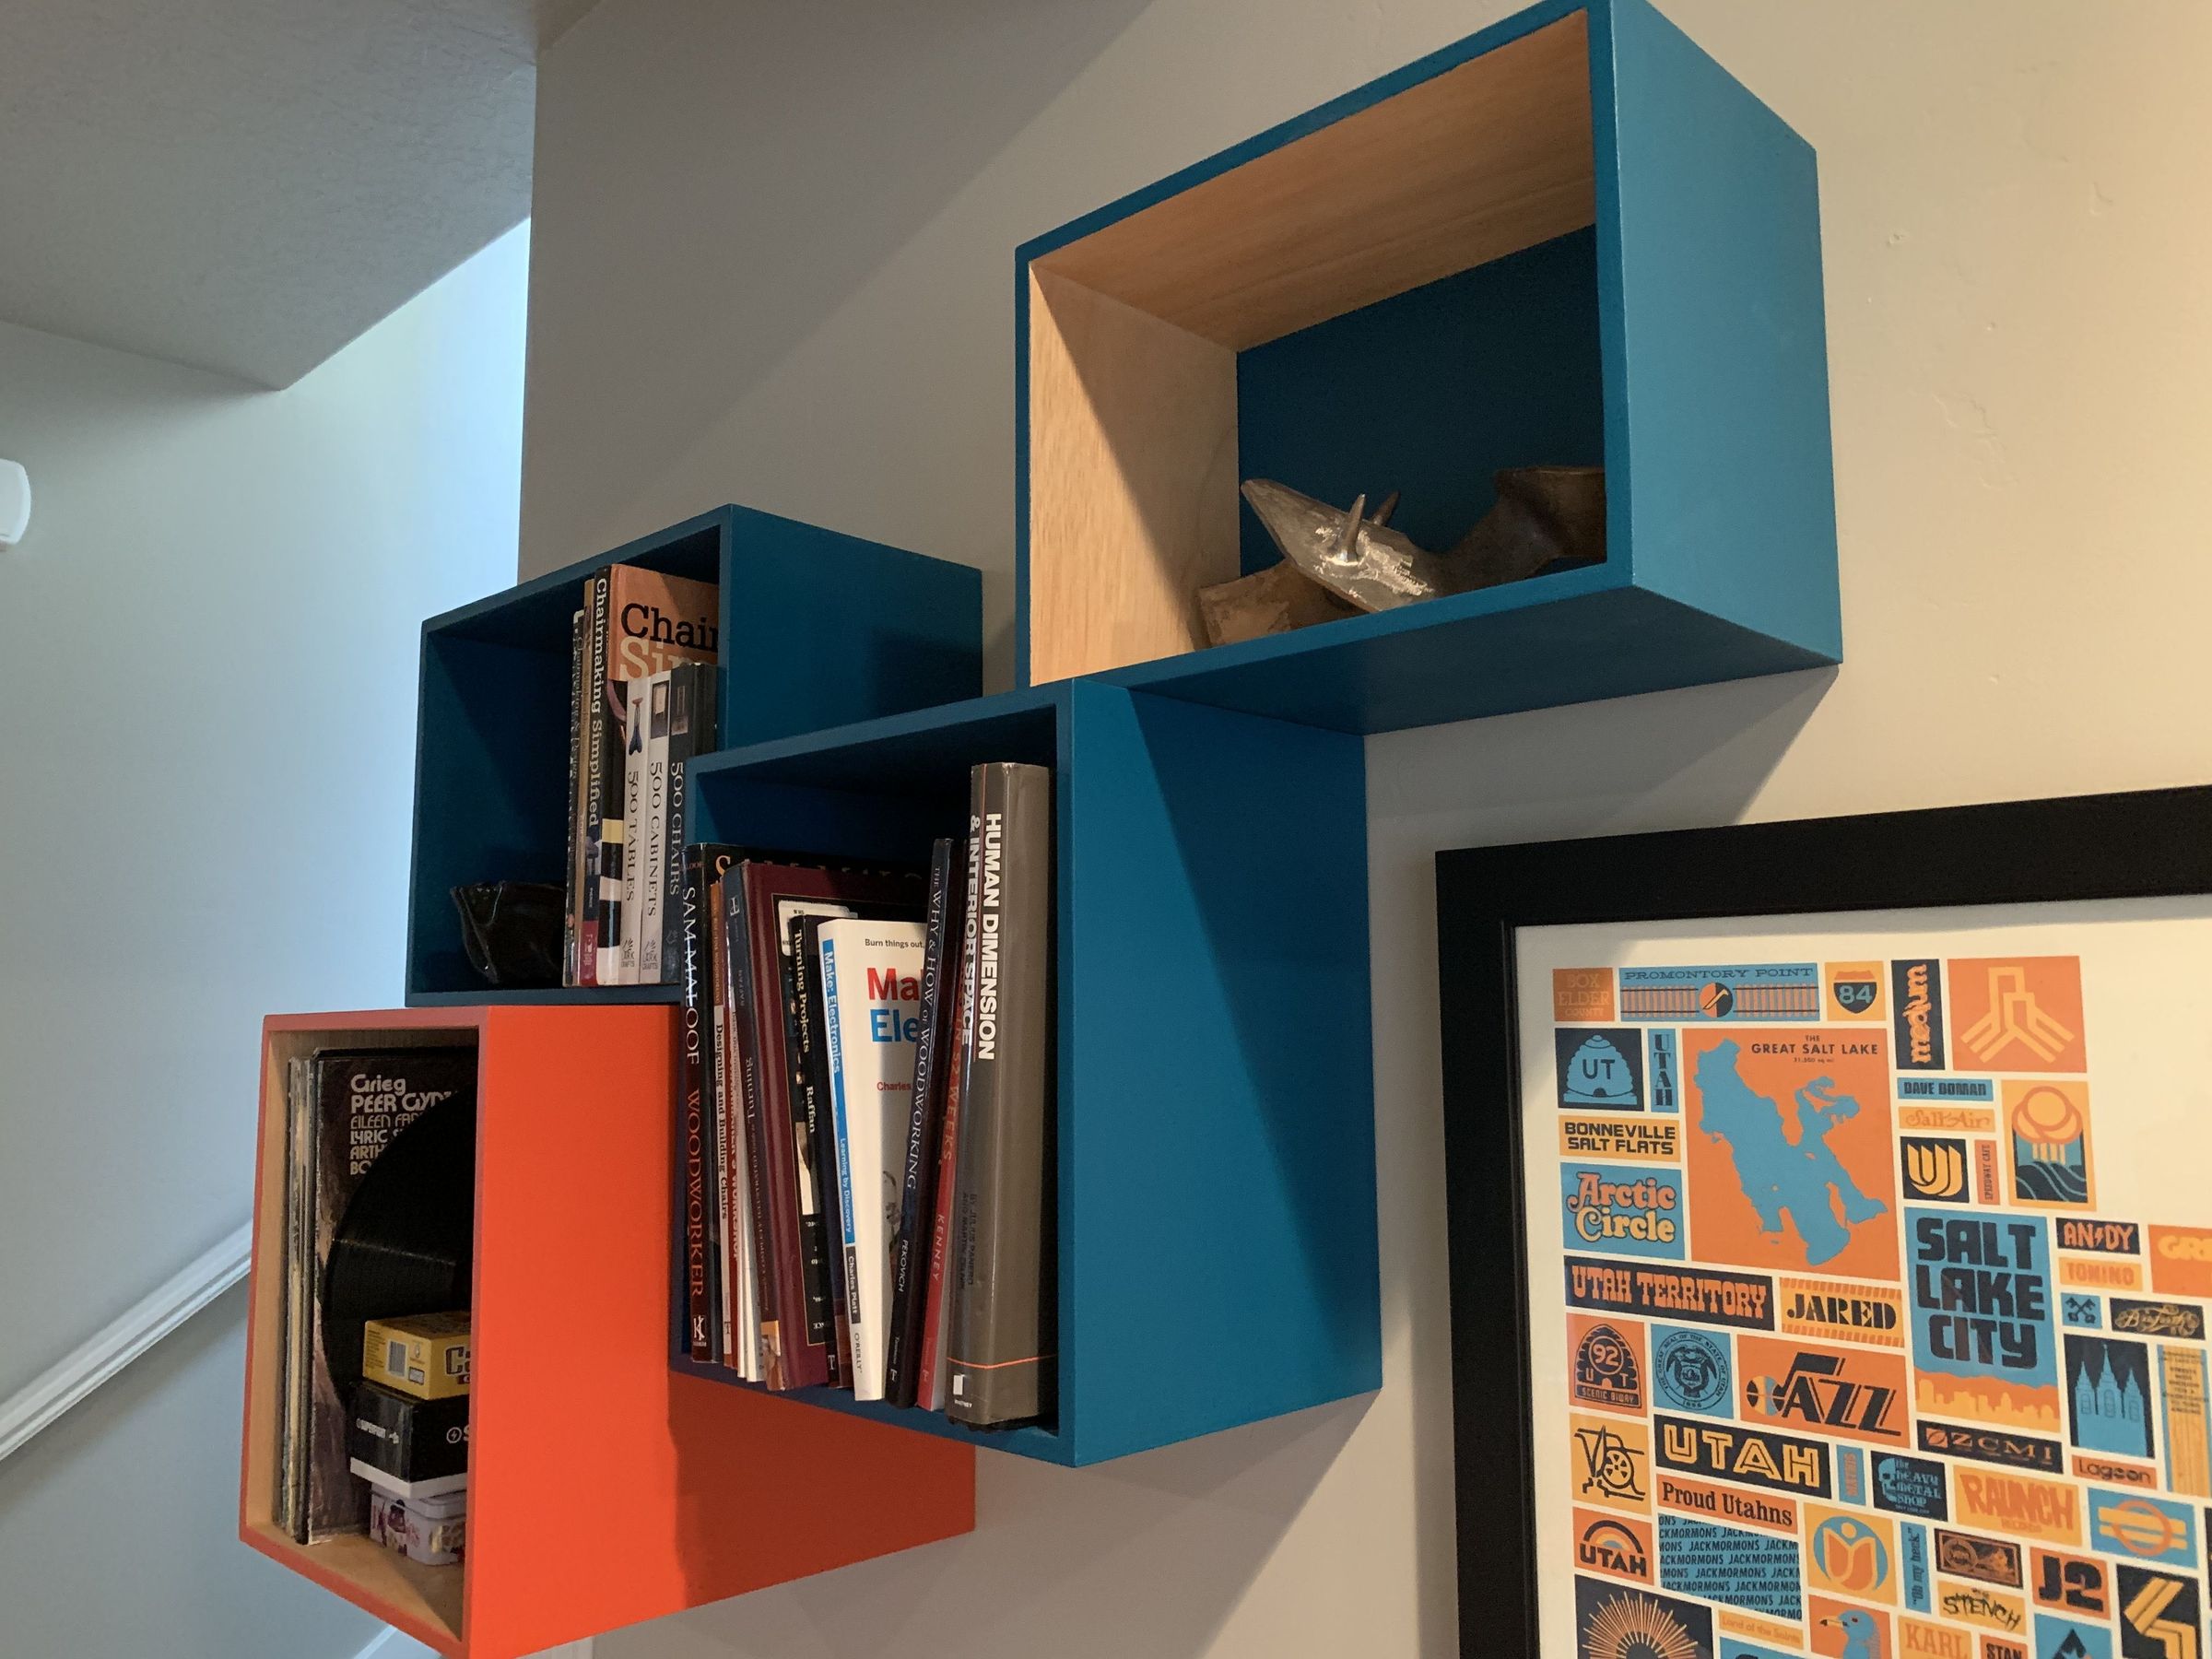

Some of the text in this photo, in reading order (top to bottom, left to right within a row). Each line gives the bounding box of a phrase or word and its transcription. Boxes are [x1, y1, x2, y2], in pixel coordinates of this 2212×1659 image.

[588, 578, 606, 826] Chairmaking Simplified
[626, 771, 639, 901] 500 TABLES
[647, 762, 663, 916] 500 CABINETS
[669, 762, 684, 896] 500 CHAIRS
[933, 867, 941, 888] THE
[682, 887, 697, 942] SAM
[929, 890, 942, 942] WHY
[960, 814, 981, 1046] & INTERIOR SPACE
[865, 939, 909, 948] Burn things
[928, 942, 936, 952] &
[977, 813, 1002, 1061] HUMAN DIMENSION
[794, 929, 810, 1053] Turning Projects
[866, 968, 924, 1001] Ma
[924, 957, 936, 1007] HOW
[1567, 973, 1601, 988] BOX
[1625, 968, 1814, 980] PROMONTORY POINT
[821, 951, 840, 1075] Make: Electronics
[1556, 991, 1611, 1006] ELDER
[1838, 984, 1873, 1006] 84
[715, 1024, 724, 1088] Designing
[1751, 1043, 1878, 1054] GREAT SALT LAKE
[1805, 1034, 1820, 1042] THE
[349, 1074, 406, 1096] Grieg
[877, 1082, 911, 1091] Charles
[1583, 1059, 1616, 1080] UT
[1653, 1034, 1674, 1107] UTAH
[1903, 1081, 1935, 1095] DAVE
[350, 1091, 453, 1113] PEER GYN
[745, 1056, 755, 1124] Turning
[906, 1026, 930, 1191] WOODWORKING
[350, 1114, 391, 1130] EILEEN
[806, 1086, 816, 1134] Raffan
[349, 1129, 388, 1146] LYRIC
[718, 1119, 727, 1172] Building
[1564, 1122, 1676, 1140] BONNEVILLE
[1568, 1137, 1674, 1155] SALT FLATS
[688, 1089, 703, 1296] WOODWORKER
[1567, 1171, 1677, 1215] Arctic
[841, 1191, 852, 1233] Discovery
[1574, 1205, 1676, 1242] Circle
[932, 1214, 945, 1283] KENNEY
[1915, 1217, 2036, 1270] SALT
[848, 1255, 856, 1288] Charles
[898, 1239, 910, 1292] PEKOVICH
[1571, 1264, 1767, 1320] UTAH TERRITORY
[1915, 1264, 2045, 1321] LAKE
[1786, 1293, 1899, 1331] JARED
[1592, 1344, 1619, 1367] 92
[1928, 1314, 2038, 1369] CITY
[1581, 1386, 1607, 1400] SCENIC
[1663, 1423, 1820, 1488] UTAH
[1950, 1431, 2053, 1462] ZCMI
[2078, 1458, 2151, 1485] Lagoon
[1662, 1481, 1794, 1527] Proud Utahns
[1959, 1474, 2074, 1530] RAUNCH
[1579, 1543, 1647, 1578] UTAH
[1688, 1539, 1760, 1552] JACKMORMONS
[1695, 1568, 1767, 1579] JACKMORMONS
[2038, 1556, 2104, 1613] J2
[1722, 1616, 1744, 1628] Land
[1747, 1622, 1755, 1631] of
[1757, 1625, 1771, 1636] the
[1943, 1593, 2021, 1630] STENCH
[1905, 1624, 1969, 1658] KARL
